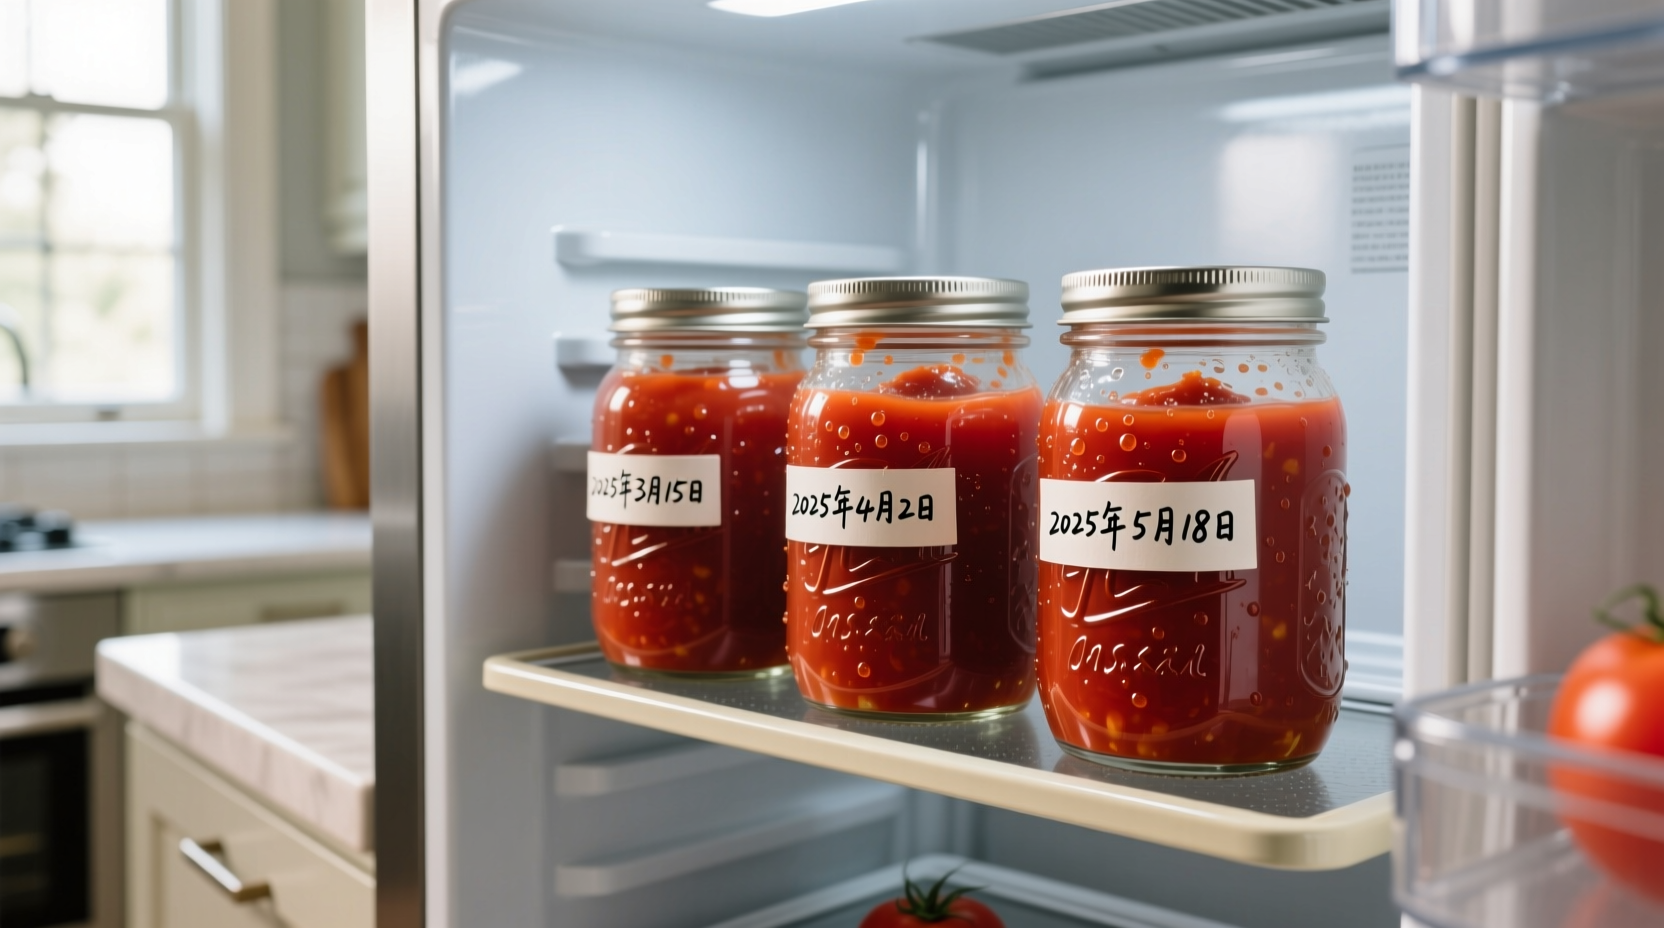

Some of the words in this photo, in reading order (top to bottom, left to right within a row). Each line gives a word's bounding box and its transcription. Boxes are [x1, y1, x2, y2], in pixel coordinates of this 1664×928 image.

[791, 484, 934, 530] 2025年4月2日
[1048, 500, 1235, 552] 2025年5月18日
